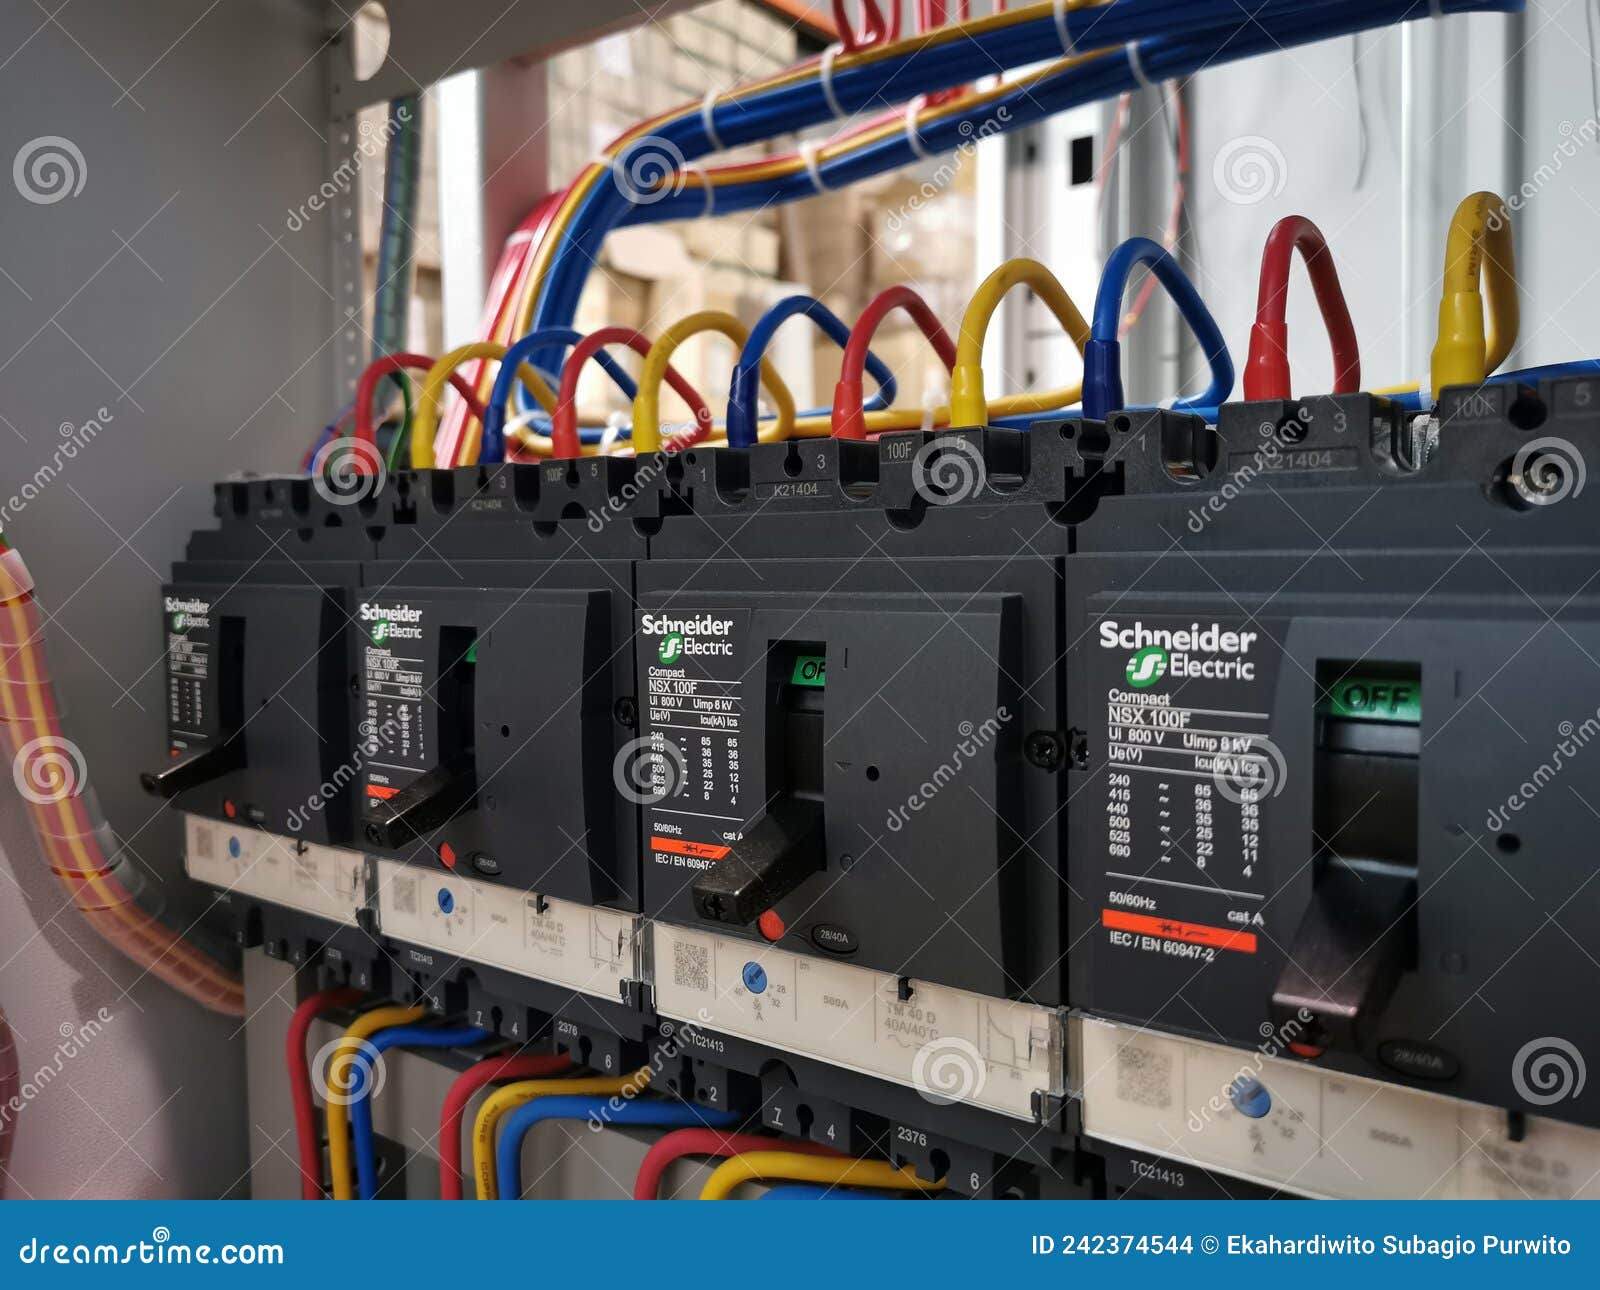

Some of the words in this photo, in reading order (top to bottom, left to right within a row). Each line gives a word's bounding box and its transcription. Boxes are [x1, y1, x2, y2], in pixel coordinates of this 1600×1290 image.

[1574, 383, 1592, 407] 5
[1334, 410, 1347, 433] 3
[887, 442, 912, 459] 100F
[955, 437, 967, 450] 5
[816, 454, 826, 469] 3
[546, 468, 563, 481] 100F
[591, 464, 597, 476] 5
[500, 476, 506, 488] 3
[774, 482, 818, 496] K21404
[166, 597, 209, 613] Schneider
[360, 602, 422, 622] Schneider
[389, 622, 422, 639] Electric
[642, 614, 733, 635] Schneider
[1100, 621, 1257, 653] Schneider
[684, 637, 733, 655] Electric
[648, 666, 685, 679] Compact
[1170, 653, 1255, 680] Electric
[648, 680, 671, 693] NSX
[673, 682, 697, 695] 100F
[661, 696, 676, 707] 800
[677, 697, 683, 708] V
[693, 698, 713, 712] Uimp
[714, 699, 720, 710] 8
[721, 700, 733, 711] kV
[1108, 688, 1170, 707] Compact
[1343, 684, 1412, 712] OFF
[650, 710, 671, 722] Ue(V)
[1108, 707, 1144, 725] NSX
[1150, 710, 1192, 729] 100F
[651, 731, 664, 741] 240
[1128, 729, 1151, 745] 800
[1154, 731, 1165, 746] V
[1183, 734, 1217, 753] Uimp
[1220, 737, 1230, 752] 8
[1232, 738, 1251, 753] kV
[651, 743, 664, 752] 415
[1108, 745, 1142, 763] Ue(V)
[650, 754, 664, 763] 440
[702, 758, 712, 768] 35
[728, 761, 738, 770] 35
[652, 764, 665, 774] 500
[703, 769, 713, 779] 25
[729, 773, 739, 783] 12
[1108, 772, 1130, 787] 240
[652, 785, 666, 795] 690
[704, 791, 710, 801] 8
[730, 796, 736, 806] 4
[703, 781, 713, 791] 22
[730, 784, 739, 794] 11
[1106, 801, 1128, 816] 440
[653, 822, 682, 835] 50/60Hz
[723, 832, 736, 841] cat
[1241, 833, 1259, 848] 12
[655, 853, 667, 864] IEC
[674, 857, 685, 867] EN
[1196, 841, 1214, 857] 22
[1241, 848, 1258, 863] 11
[1242, 864, 1252, 878] 4
[1109, 891, 1157, 911] 50/60Hz
[1227, 910, 1250, 924] cat
[1252, 912, 1264, 926] A
[820, 929, 848, 944] 28/40A
[1110, 931, 1132, 947] IEC
[1142, 936, 1160, 952] EN
[1163, 941, 1214, 963] 60947-2
[887, 1002, 903, 1017] TM
[926, 1011, 936, 1024] D
[511, 1022, 518, 1035] 4
[558, 1020, 578, 1036] 2376
[690, 1032, 724, 1053] TC21413
[605, 1054, 612, 1069] 6
[710, 1086, 718, 1102] 2
[827, 1124, 836, 1141] 4
[897, 1126, 927, 1146] 2376
[970, 1172, 980, 1190] 6
[1130, 1159, 1185, 1187] TC21413
